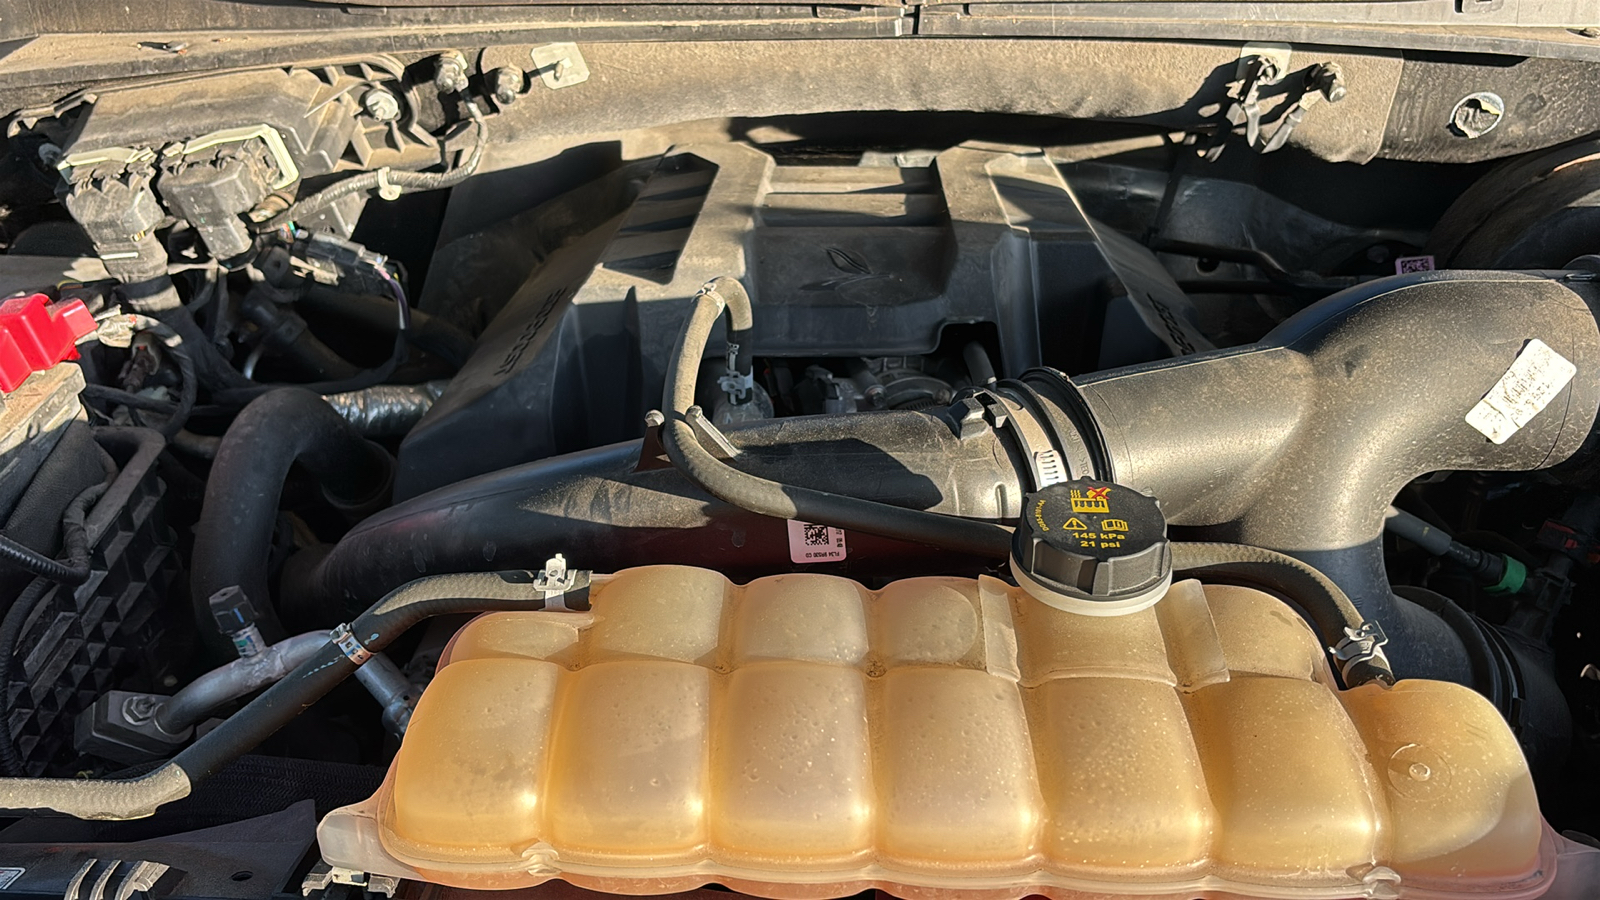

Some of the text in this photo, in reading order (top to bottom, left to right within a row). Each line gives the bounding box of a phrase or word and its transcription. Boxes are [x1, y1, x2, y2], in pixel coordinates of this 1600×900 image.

[1072, 532, 1126, 540] 145 kPa
[1101, 541, 1120, 549] psi
